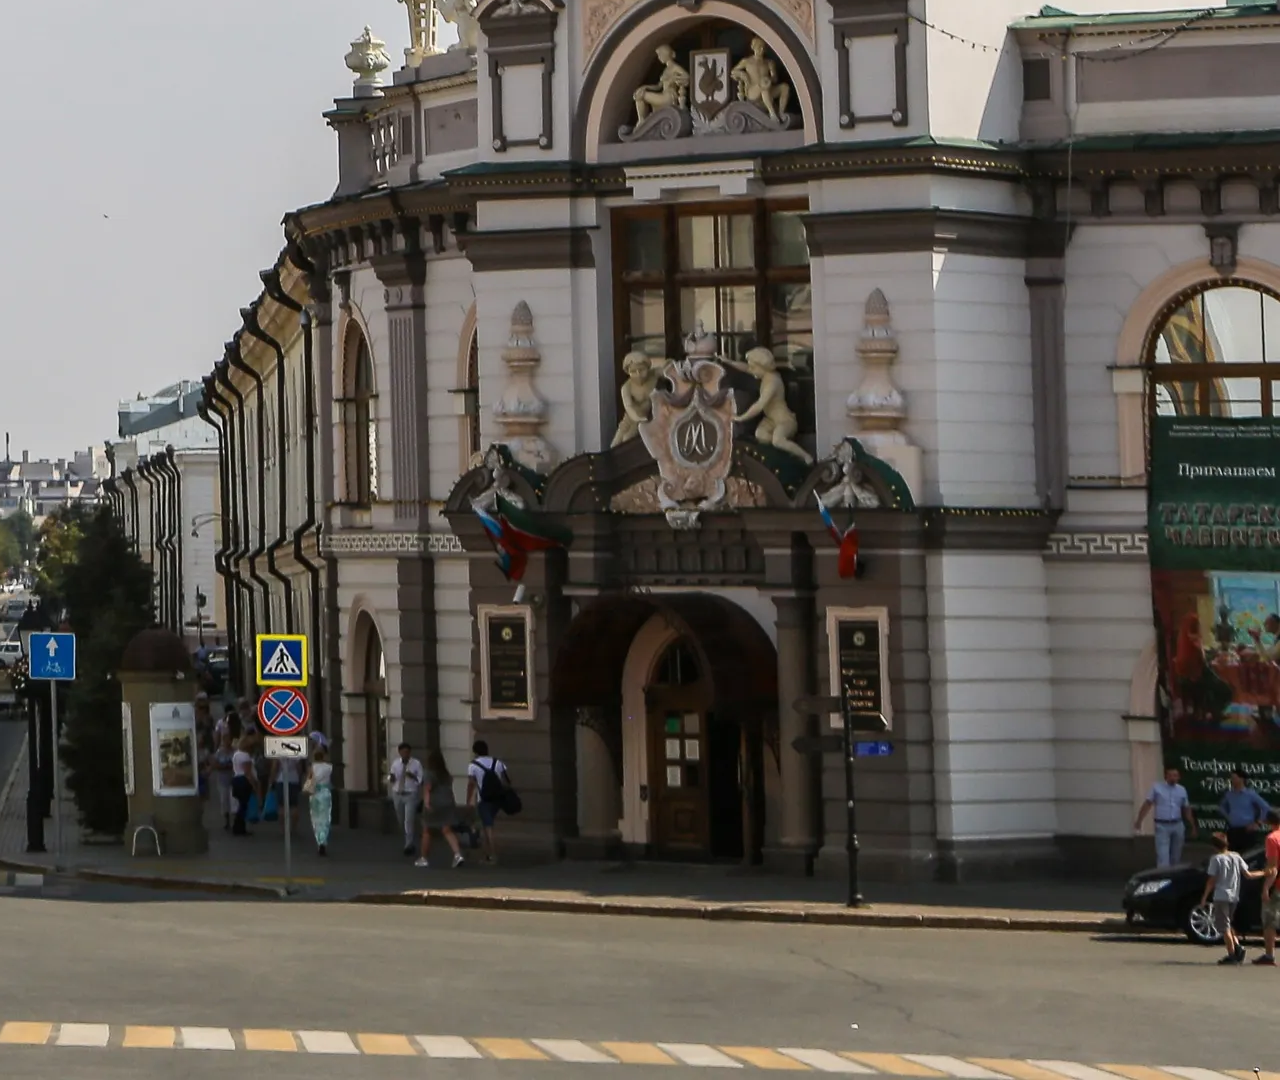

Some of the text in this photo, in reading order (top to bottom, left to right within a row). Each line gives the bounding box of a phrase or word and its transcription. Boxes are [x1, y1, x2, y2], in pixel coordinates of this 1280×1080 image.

[1178, 462, 1276, 479] Приглашаем
[1159, 502, 1280, 525] ТАТАРСК
[1180, 756, 1237, 775] Телефон
